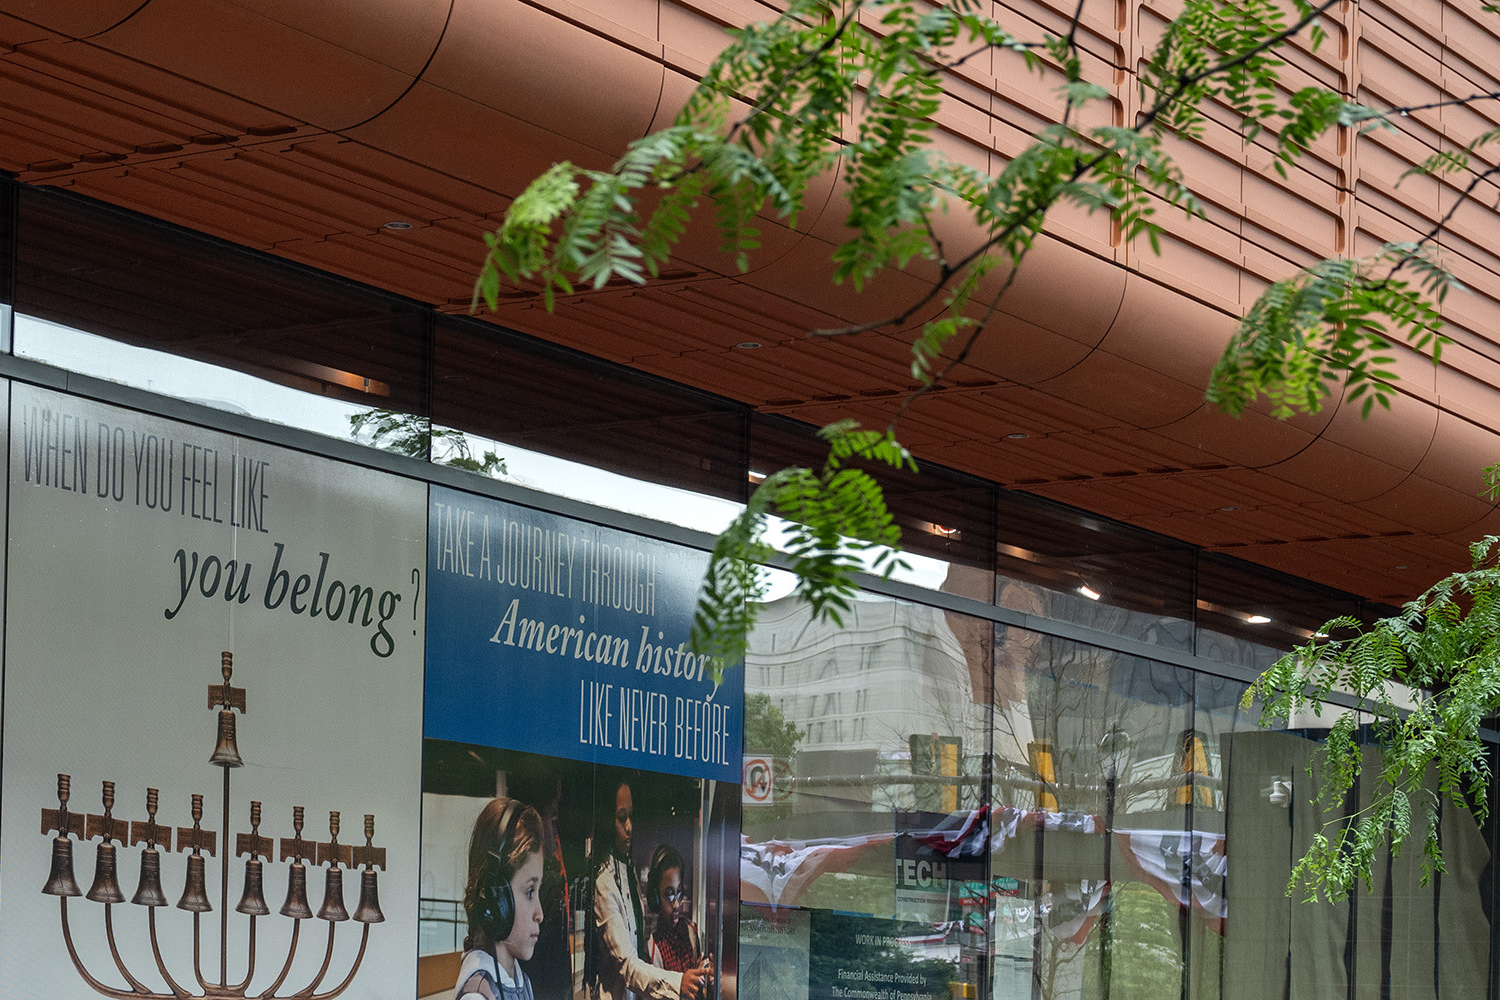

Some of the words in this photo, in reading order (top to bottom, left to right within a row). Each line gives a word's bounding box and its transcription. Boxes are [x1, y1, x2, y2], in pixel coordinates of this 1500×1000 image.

[22, 404, 89, 497] WHEN
[97, 423, 125, 503] DO
[133, 431, 173, 515] YOU
[181, 442, 223, 524] FEEL
[231, 454, 269, 534] LIKE
[164, 546, 251, 620] you
[434, 502, 475, 575] TAKE
[478, 514, 492, 582] A
[496, 520, 576, 599] JOURNEY
[580, 534, 655, 616] THROUGH
[491, 598, 629, 669] American
[635, 626, 724, 702] history
[580, 679, 612, 748] LIKE
[618, 685, 668, 757] NEVER
[675, 694, 730, 766] BEFORE
[838, 968, 863, 981] Financial
[864, 970, 894, 982] Assistance
[895, 972, 918, 984] Provided
[919, 975, 927, 987] by
[856, 934, 874, 945] WORK
[875, 936, 882, 946] IN
[832, 986, 843, 997] The
[844, 987, 888, 1000] Commonwealth
[889, 989, 897, 1000] of
